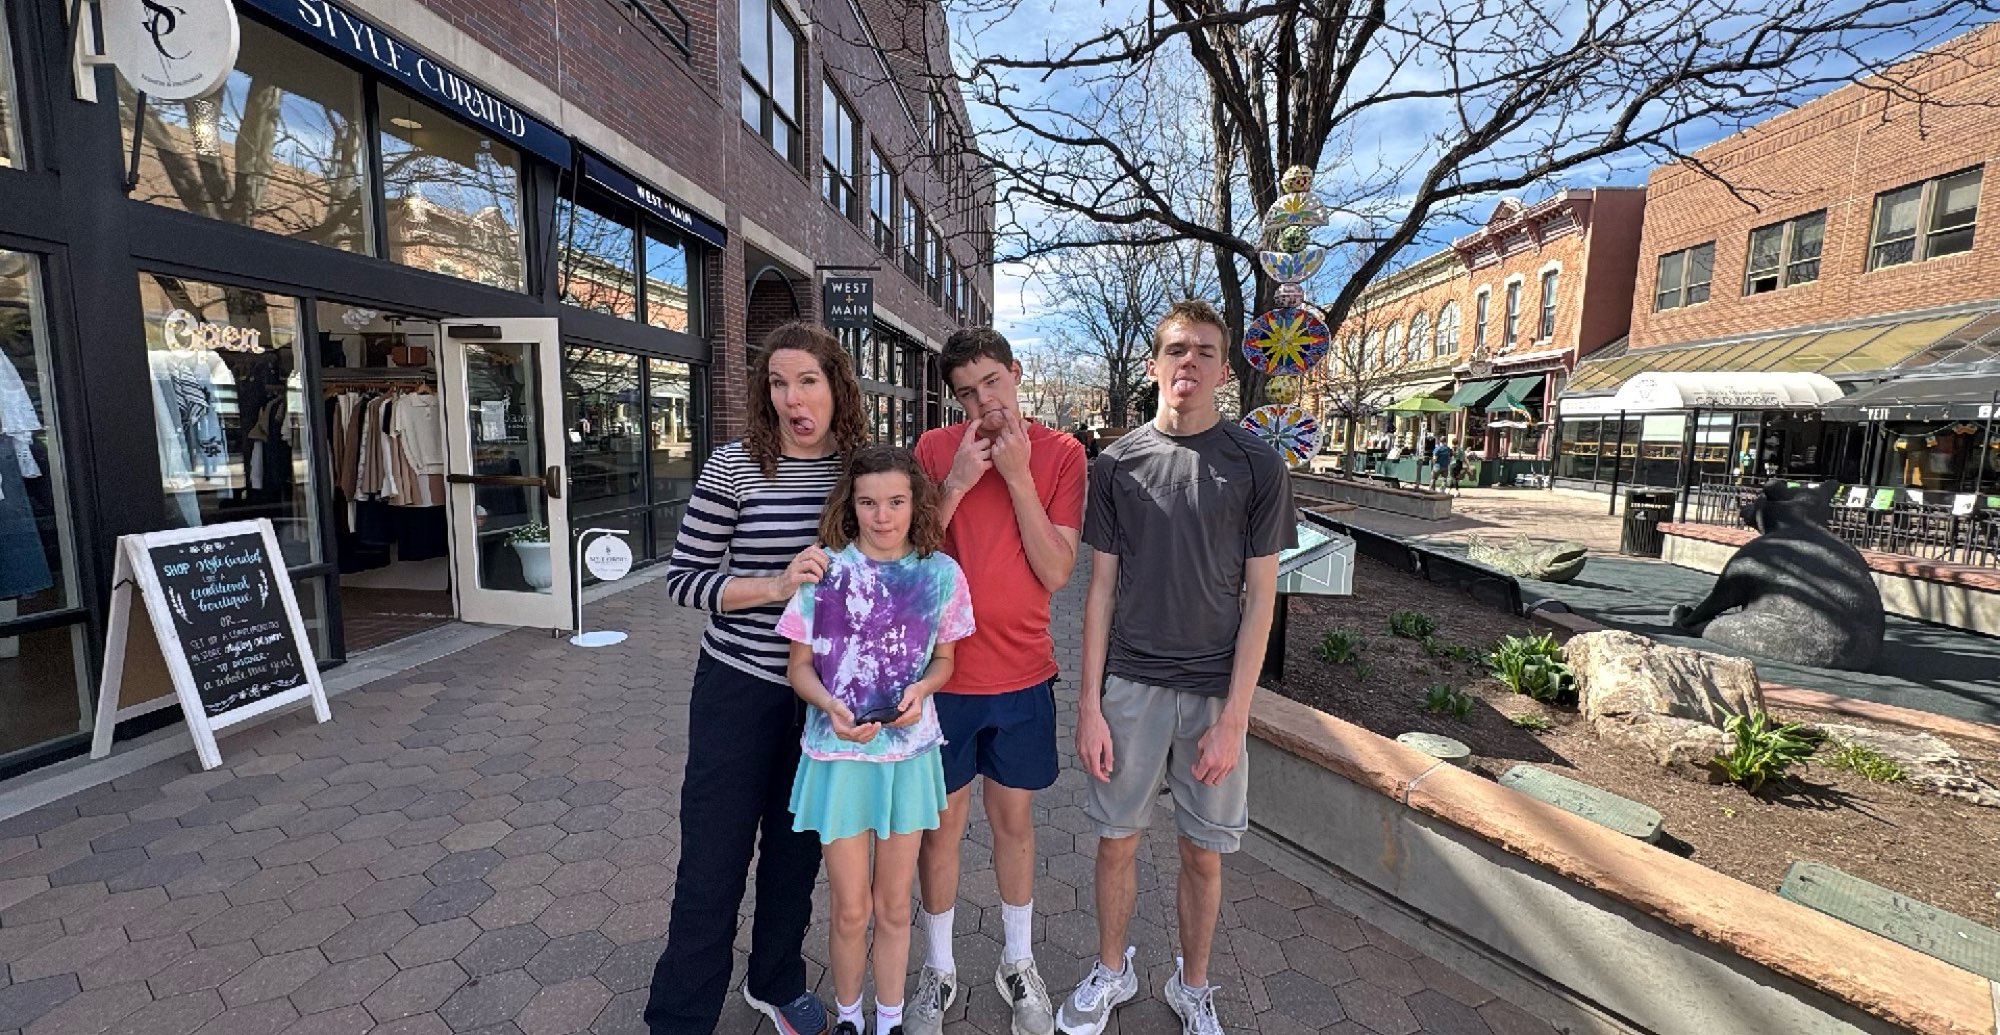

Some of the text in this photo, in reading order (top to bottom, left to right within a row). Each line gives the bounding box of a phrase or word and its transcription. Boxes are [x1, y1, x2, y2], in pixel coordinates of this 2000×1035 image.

[298, 0, 526, 137] STYLE CURATED
[636, 184, 662, 209] WEST
[669, 203, 692, 226] MAIN
[831, 282, 868, 294] WEST
[831, 304, 868, 316] MAIN
[164, 308, 266, 364] Open
[163, 562, 190, 577] SHOP
[189, 575, 250, 600] traditional
[198, 592, 252, 612] boutique
[232, 652, 267, 669] DISCOVER
[203, 682, 213, 691] a
